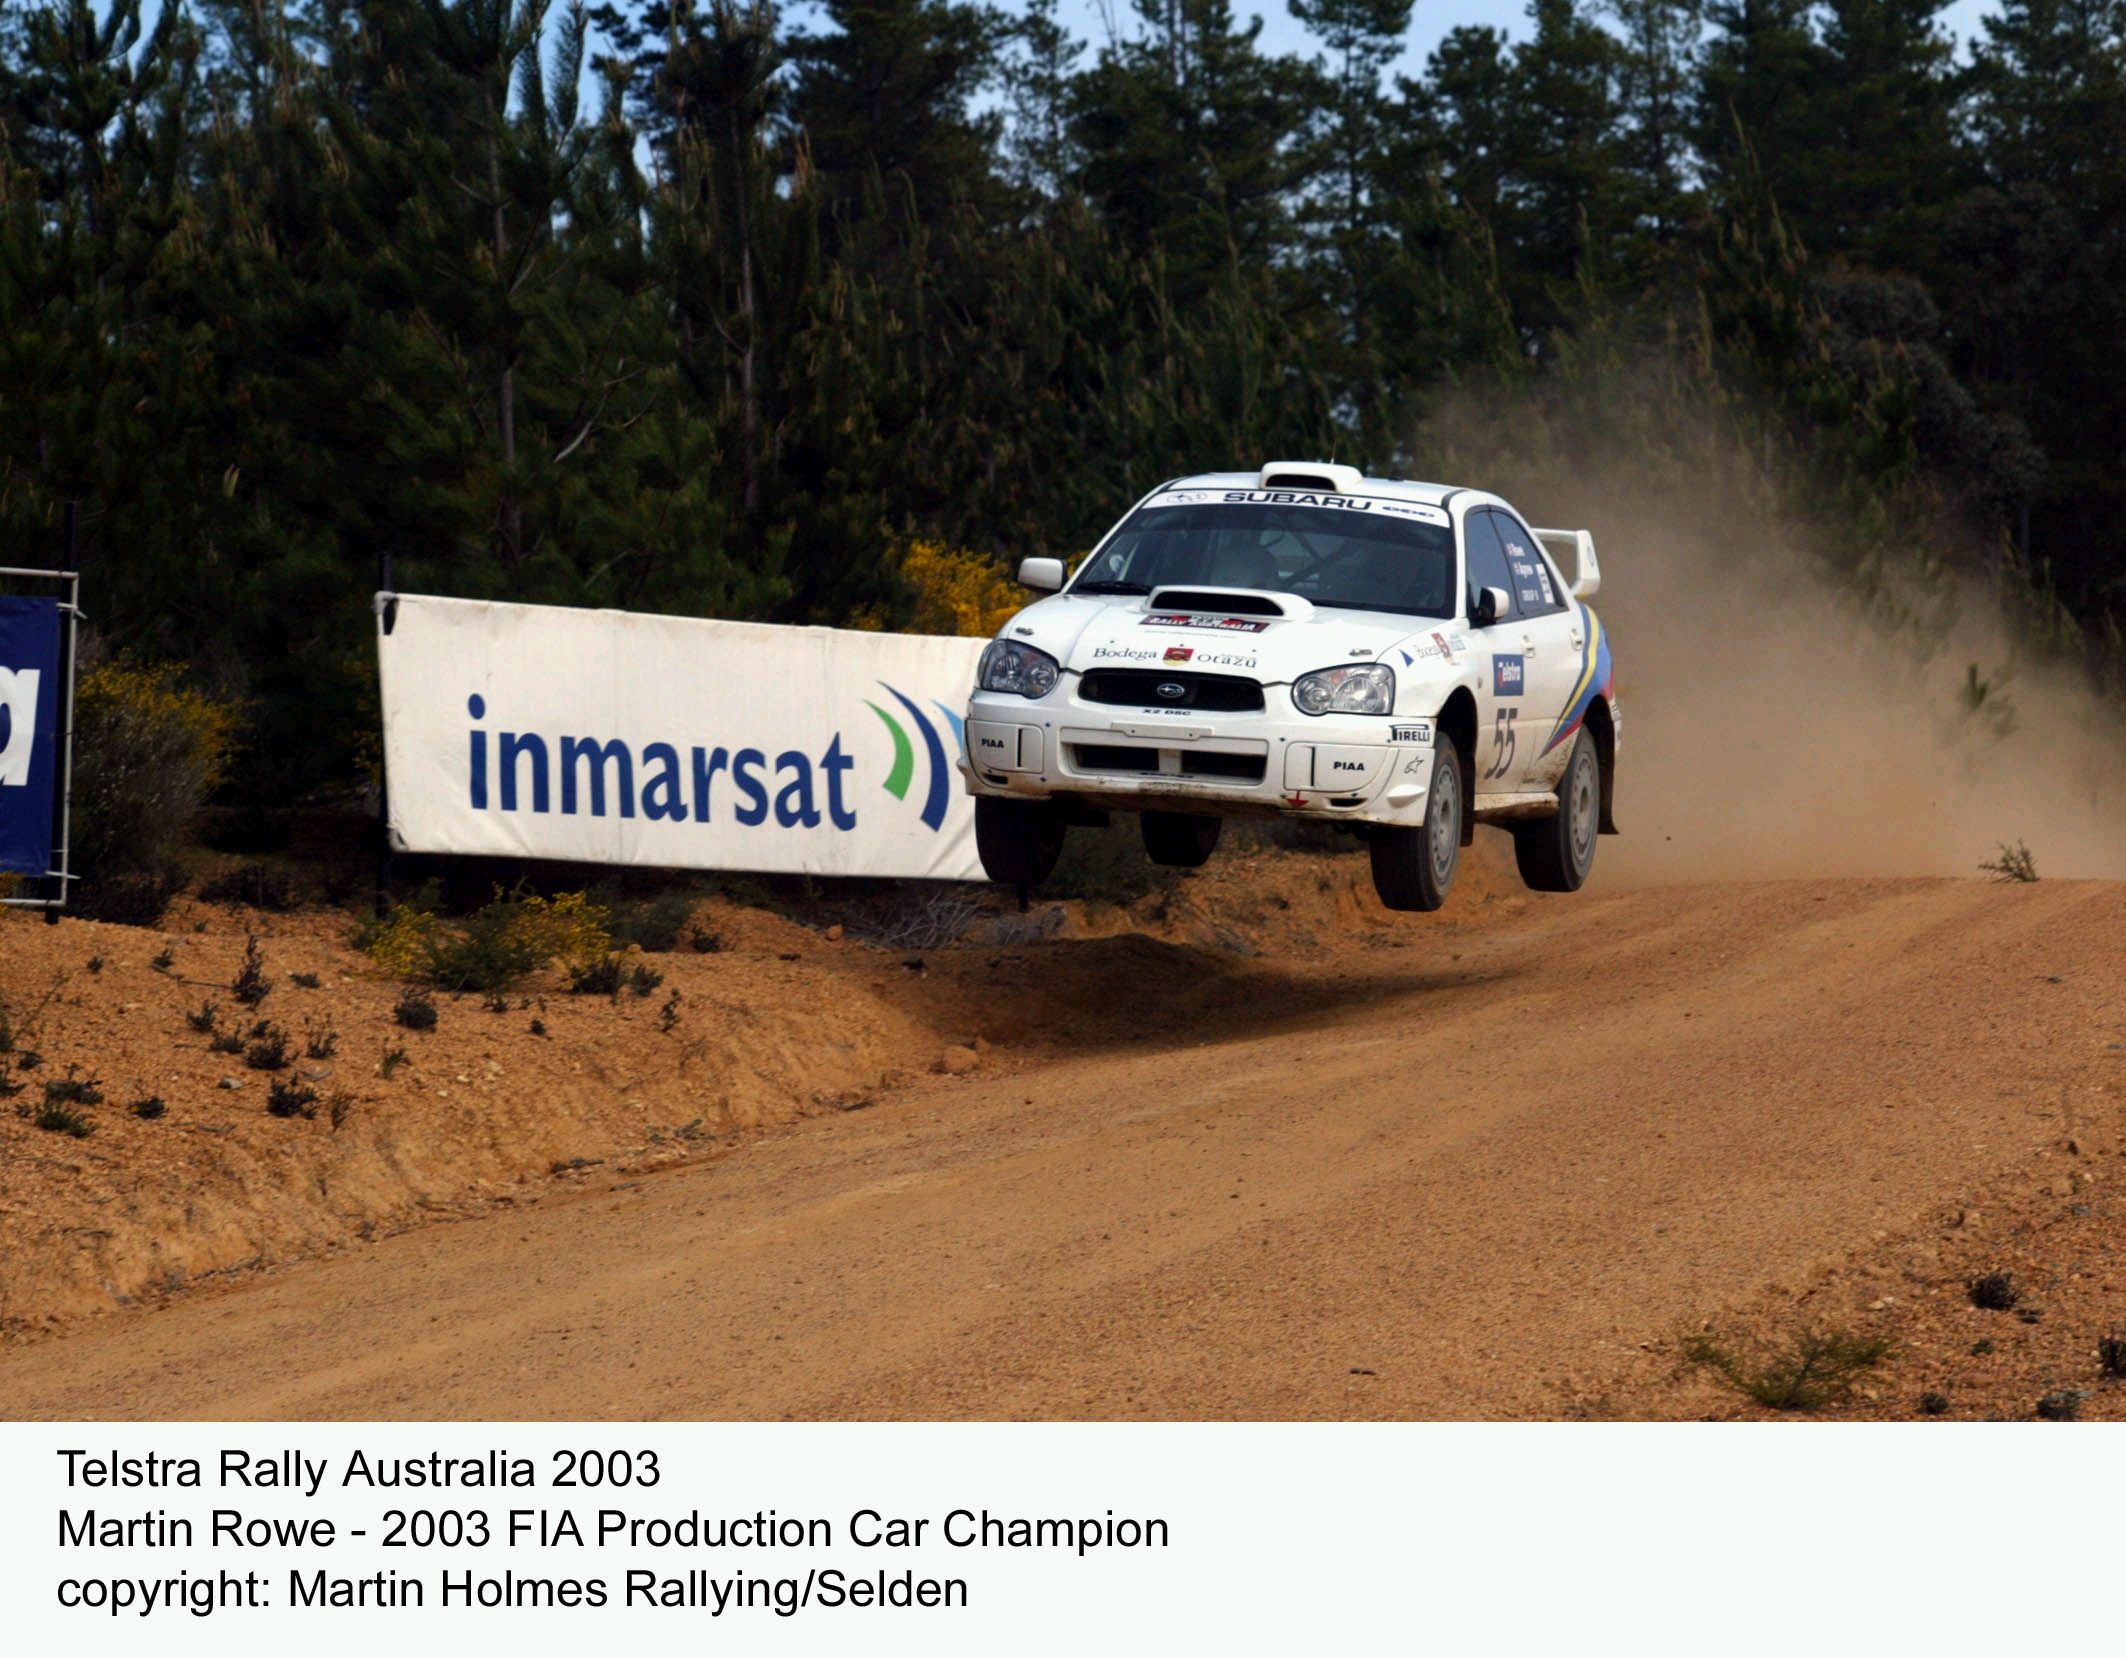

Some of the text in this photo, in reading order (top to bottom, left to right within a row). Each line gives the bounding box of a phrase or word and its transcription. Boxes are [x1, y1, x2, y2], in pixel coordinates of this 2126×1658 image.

[1223, 492, 1372, 510] SUBARU
[1149, 616, 1186, 626] RALLY
[1093, 647, 1157, 661] Bodega
[1388, 724, 1429, 743] PIRELLI
[981, 738, 1004, 748] PIAA
[1484, 708, 1518, 779] 55
[468, 693, 857, 832] inmarsat
[1333, 761, 1365, 771] PIAA
